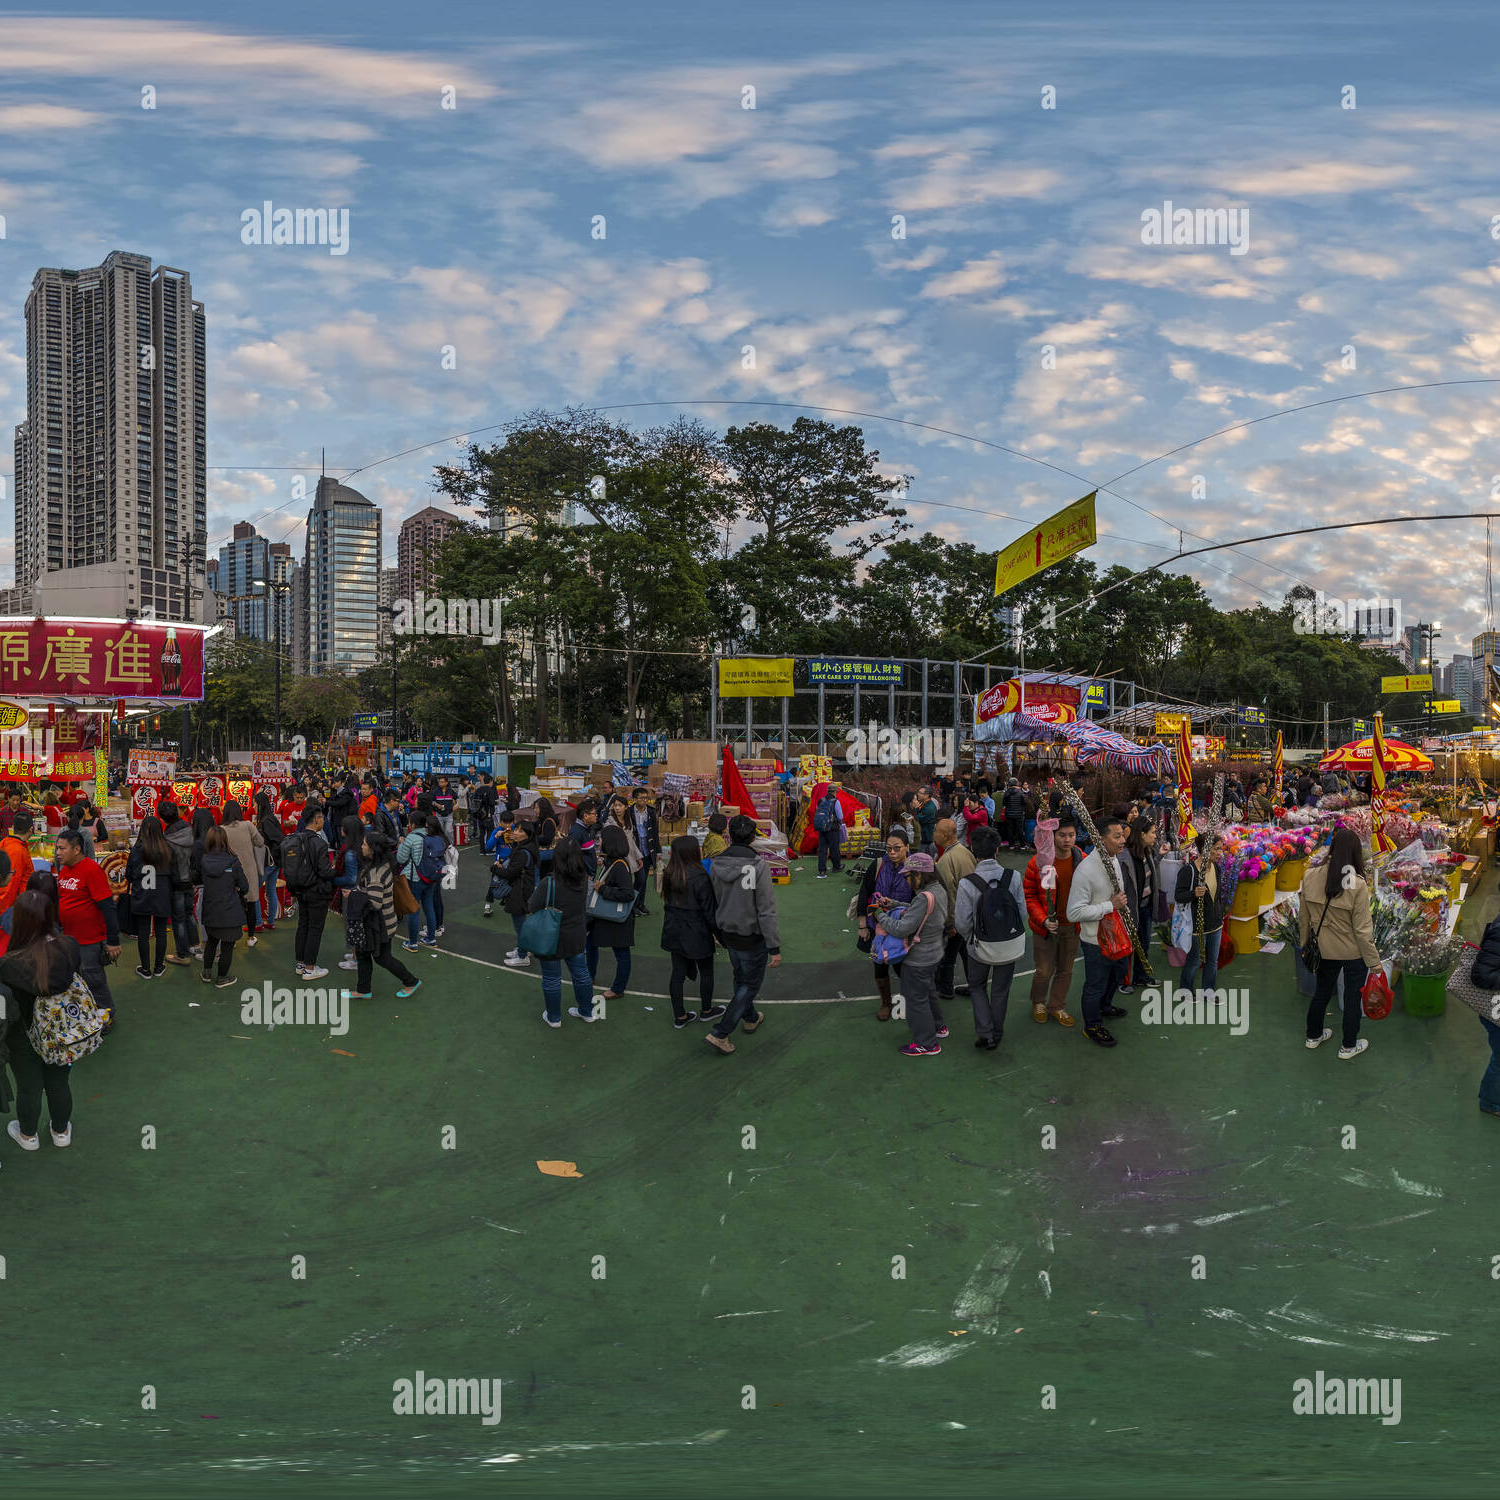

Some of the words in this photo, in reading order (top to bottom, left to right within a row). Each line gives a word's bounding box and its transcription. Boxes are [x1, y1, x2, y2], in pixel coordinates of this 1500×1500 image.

[1003, 558, 1016, 574] ONE
[1016, 550, 1031, 563] WAY
[812, 662, 901, 674] 請小心保管個人財物
